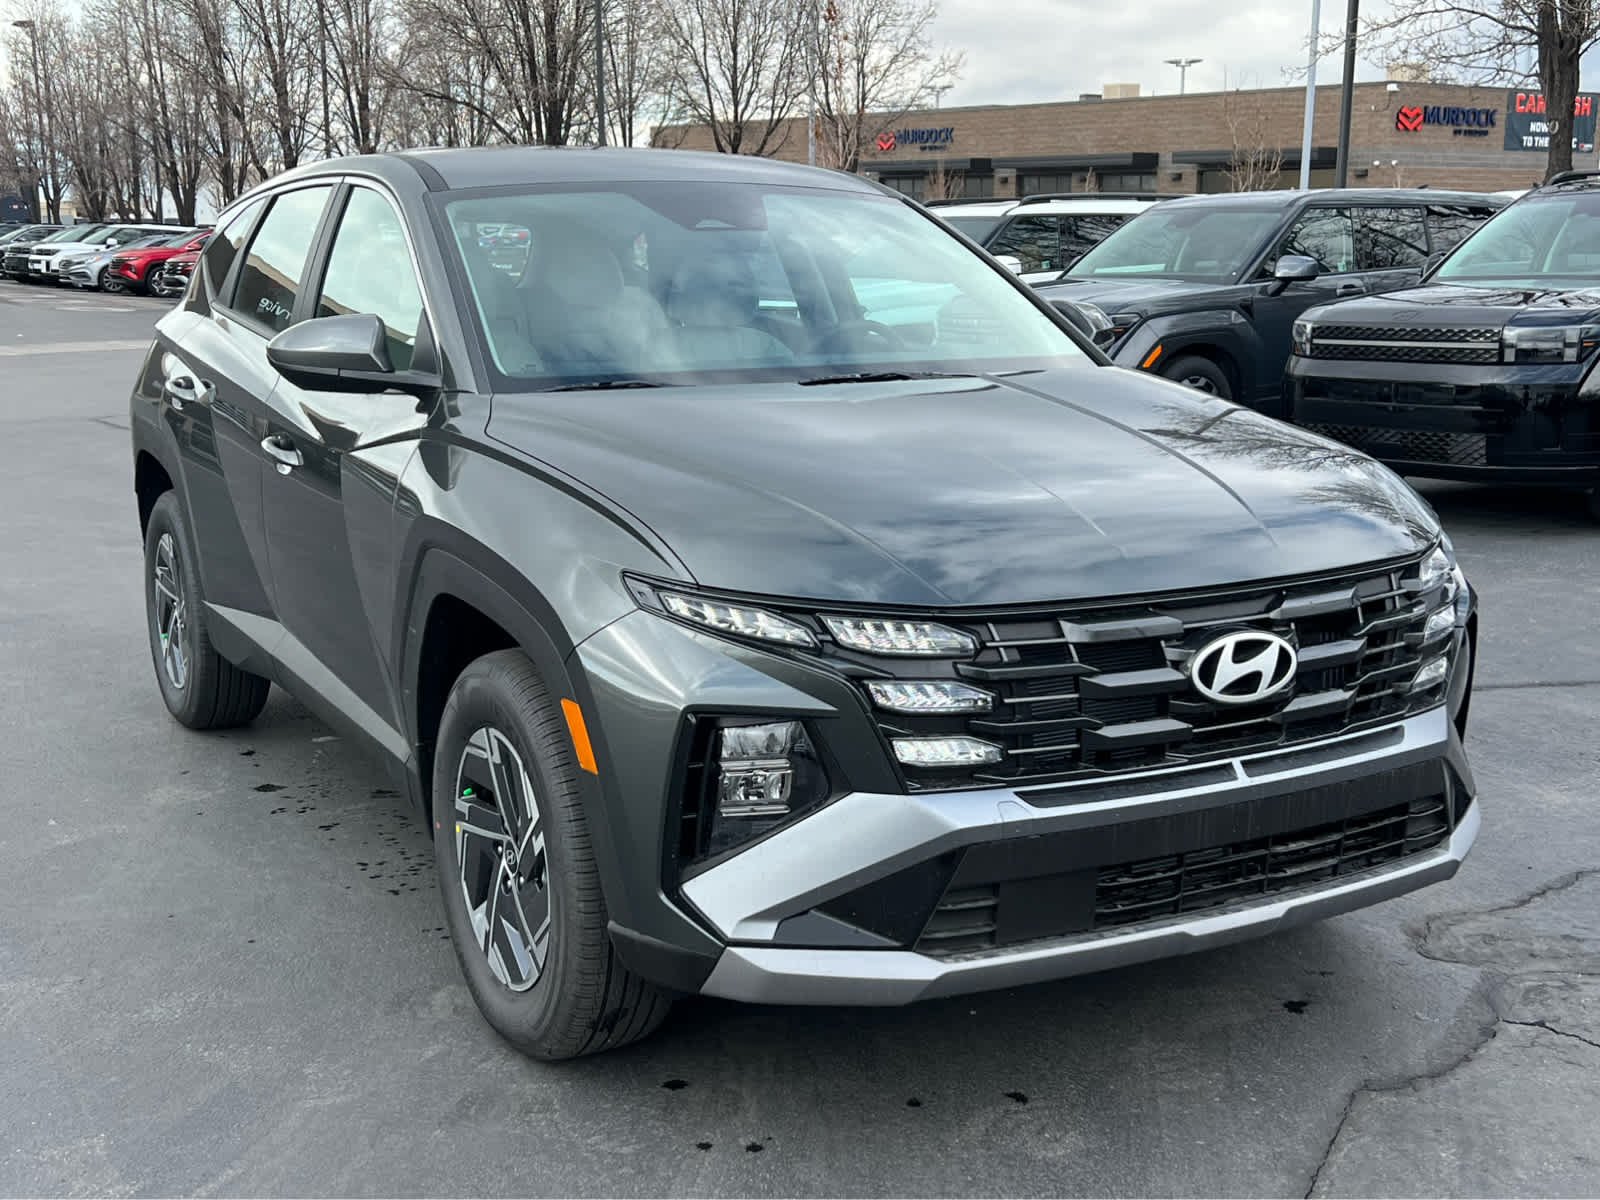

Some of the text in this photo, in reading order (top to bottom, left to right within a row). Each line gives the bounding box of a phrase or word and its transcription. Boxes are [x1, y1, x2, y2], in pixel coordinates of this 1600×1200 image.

[1424, 105, 1498, 128] MURDOCK
[1522, 136, 1551, 148] TO THE
